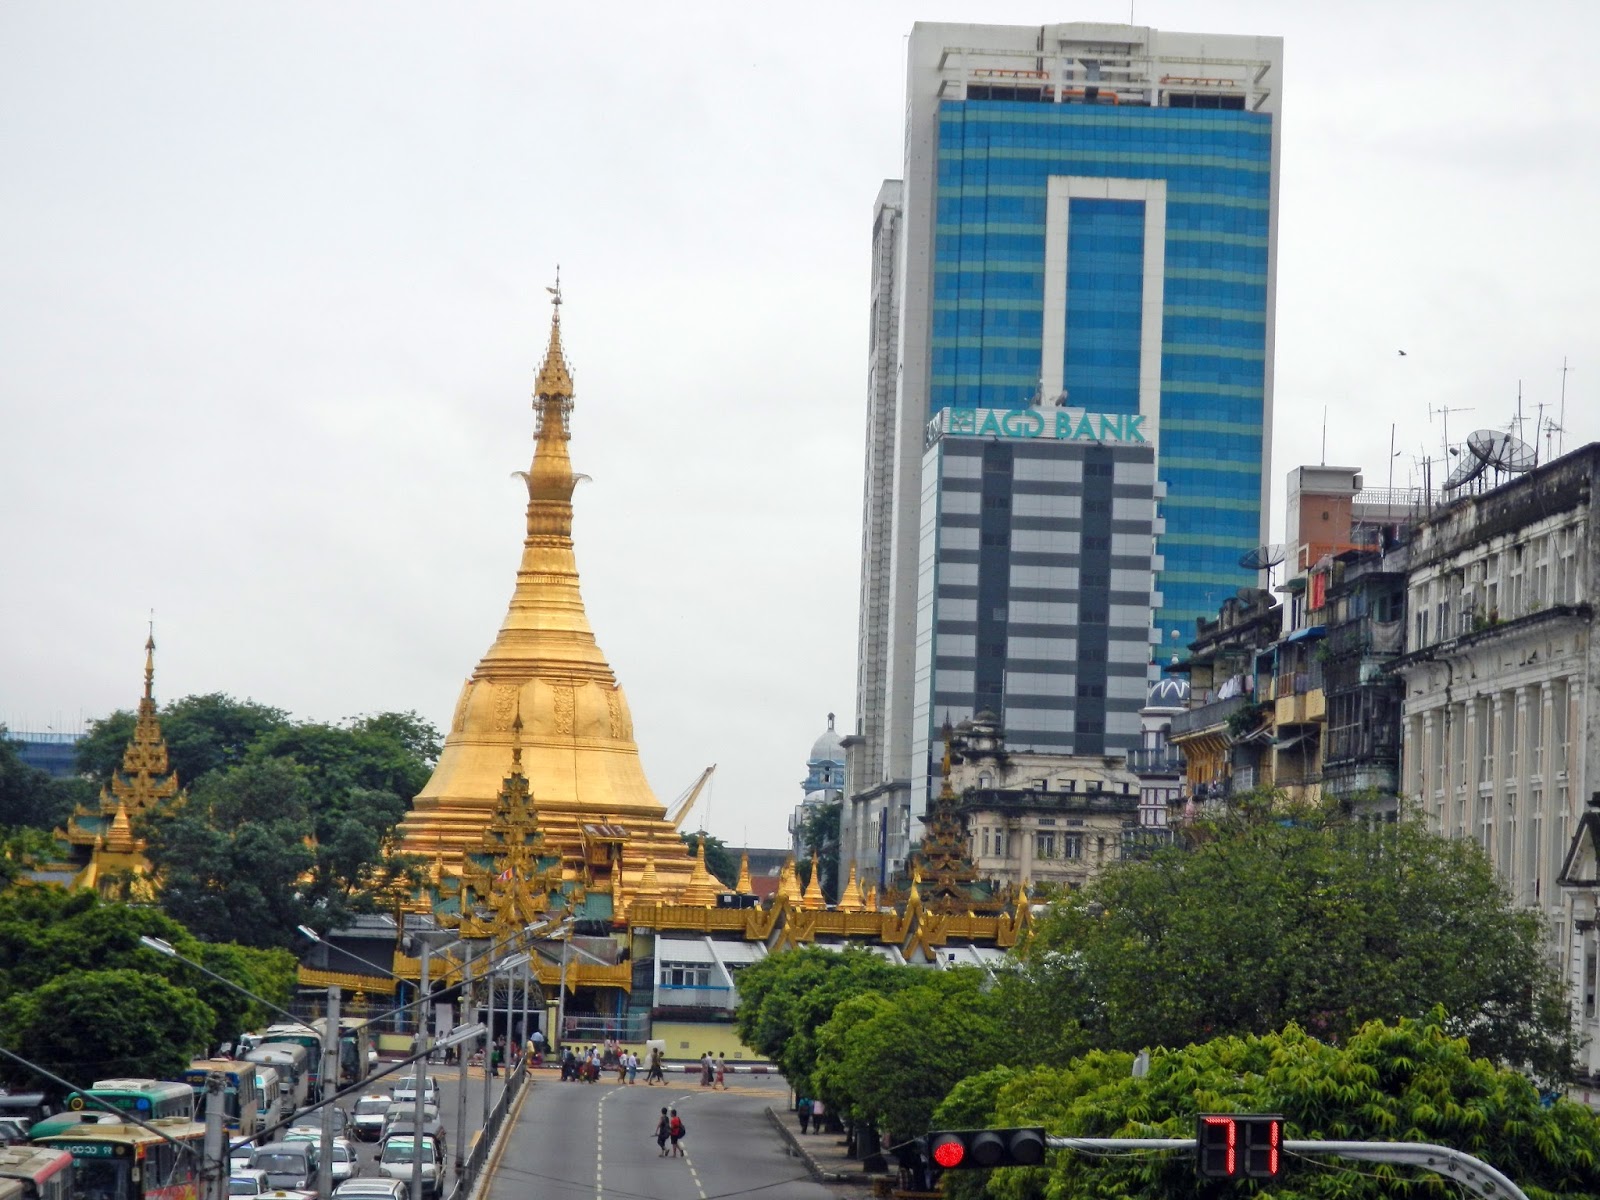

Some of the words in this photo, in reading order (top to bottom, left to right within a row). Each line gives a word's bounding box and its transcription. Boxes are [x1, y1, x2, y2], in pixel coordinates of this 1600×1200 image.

[979, 409, 1045, 437] AGD
[1056, 412, 1147, 442] BANK
[1204, 1117, 1279, 1175] 71
